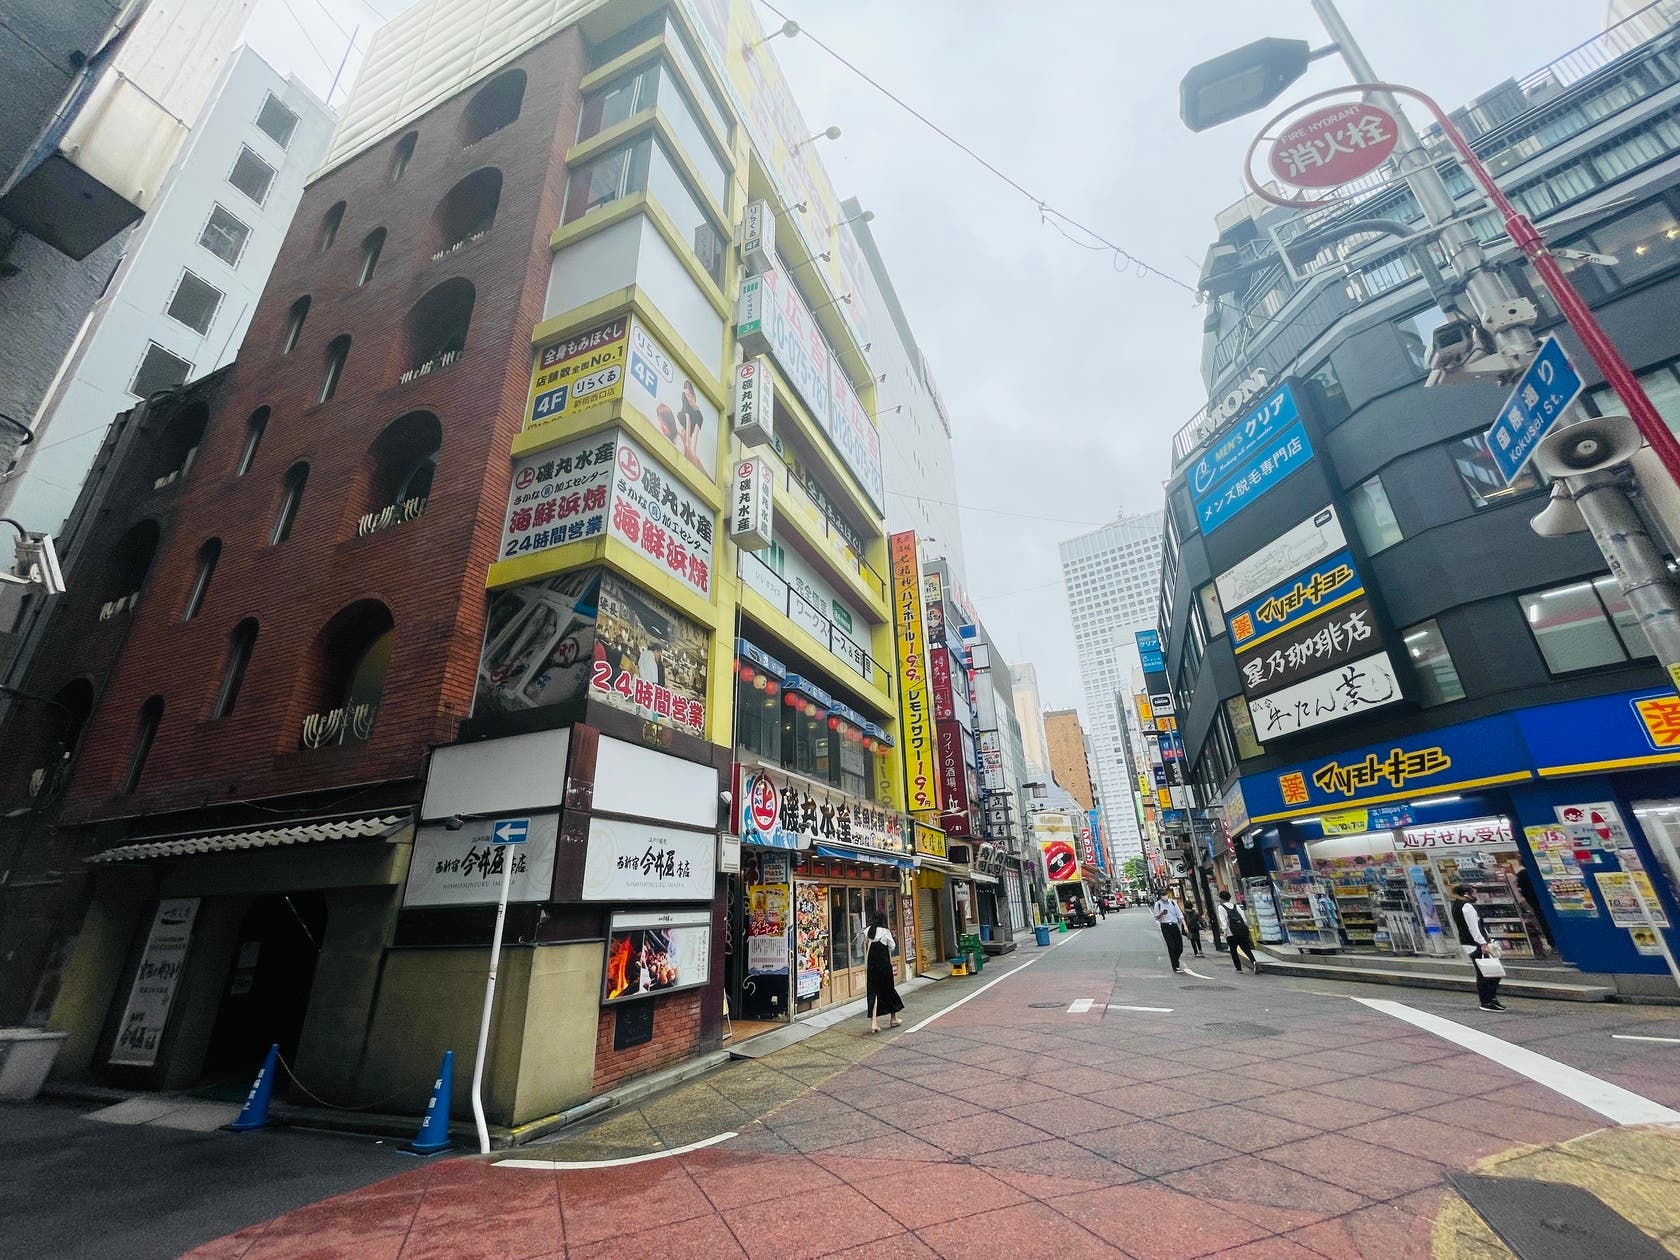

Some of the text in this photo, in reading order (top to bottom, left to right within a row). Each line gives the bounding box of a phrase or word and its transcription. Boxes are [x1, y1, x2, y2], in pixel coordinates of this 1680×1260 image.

[1278, 115, 1391, 177] 消火栓
[1282, 105, 1360, 144] FIRE HYDRANT
[543, 324, 624, 366] 全身もみほぐし
[635, 332, 671, 378] りらくる
[576, 370, 618, 394] りらくる
[633, 361, 657, 389] 4F
[536, 391, 564, 414] 4F
[740, 379, 753, 426] 磯丸水産
[1215, 432, 1243, 462] MEN'S
[1245, 392, 1284, 438] クリア
[1496, 359, 1555, 451] 国際通り
[1543, 394, 1564, 414] St.
[535, 441, 615, 483] 磯丸水産
[1203, 435, 1303, 522] メンズ脱毛専門店
[509, 484, 607, 535] 海鮮浜焼
[641, 465, 712, 545] 磯丸水産
[737, 478, 752, 532] 磯丸水産
[505, 514, 604, 557] 24時間営業
[613, 495, 708, 593] 海鮮浜焼
[1256, 564, 1353, 623] マツモトキヨシ
[1242, 609, 1373, 689] 星乃珈琲店
[592, 659, 706, 731] 24時間営業
[1280, 748, 1449, 803] 薬 マツモトキヨシ
[1403, 825, 1514, 849] 処方せん受付
